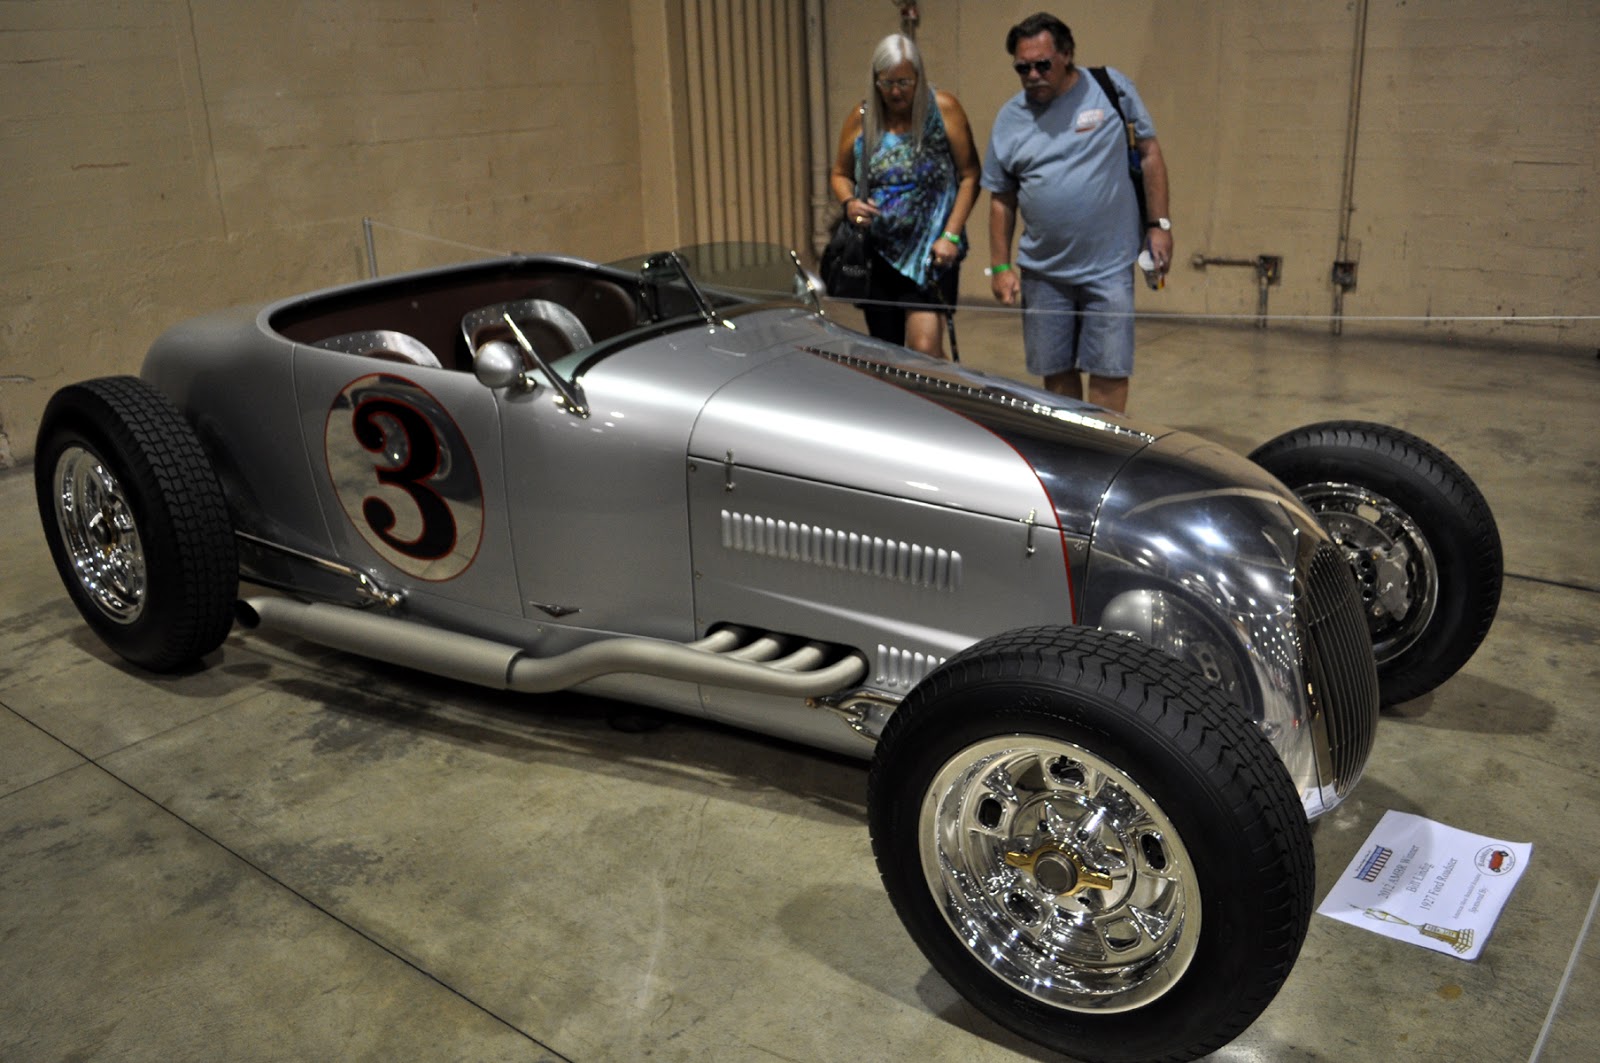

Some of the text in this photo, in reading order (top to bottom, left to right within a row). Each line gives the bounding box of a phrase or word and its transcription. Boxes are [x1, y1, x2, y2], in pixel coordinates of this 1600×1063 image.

[352, 397, 457, 561] 3
[1377, 883, 1395, 899] 2012
[1405, 880, 1420, 893] Bill
[1419, 894, 1436, 910] 1927
[1428, 880, 1444, 896] Ford
